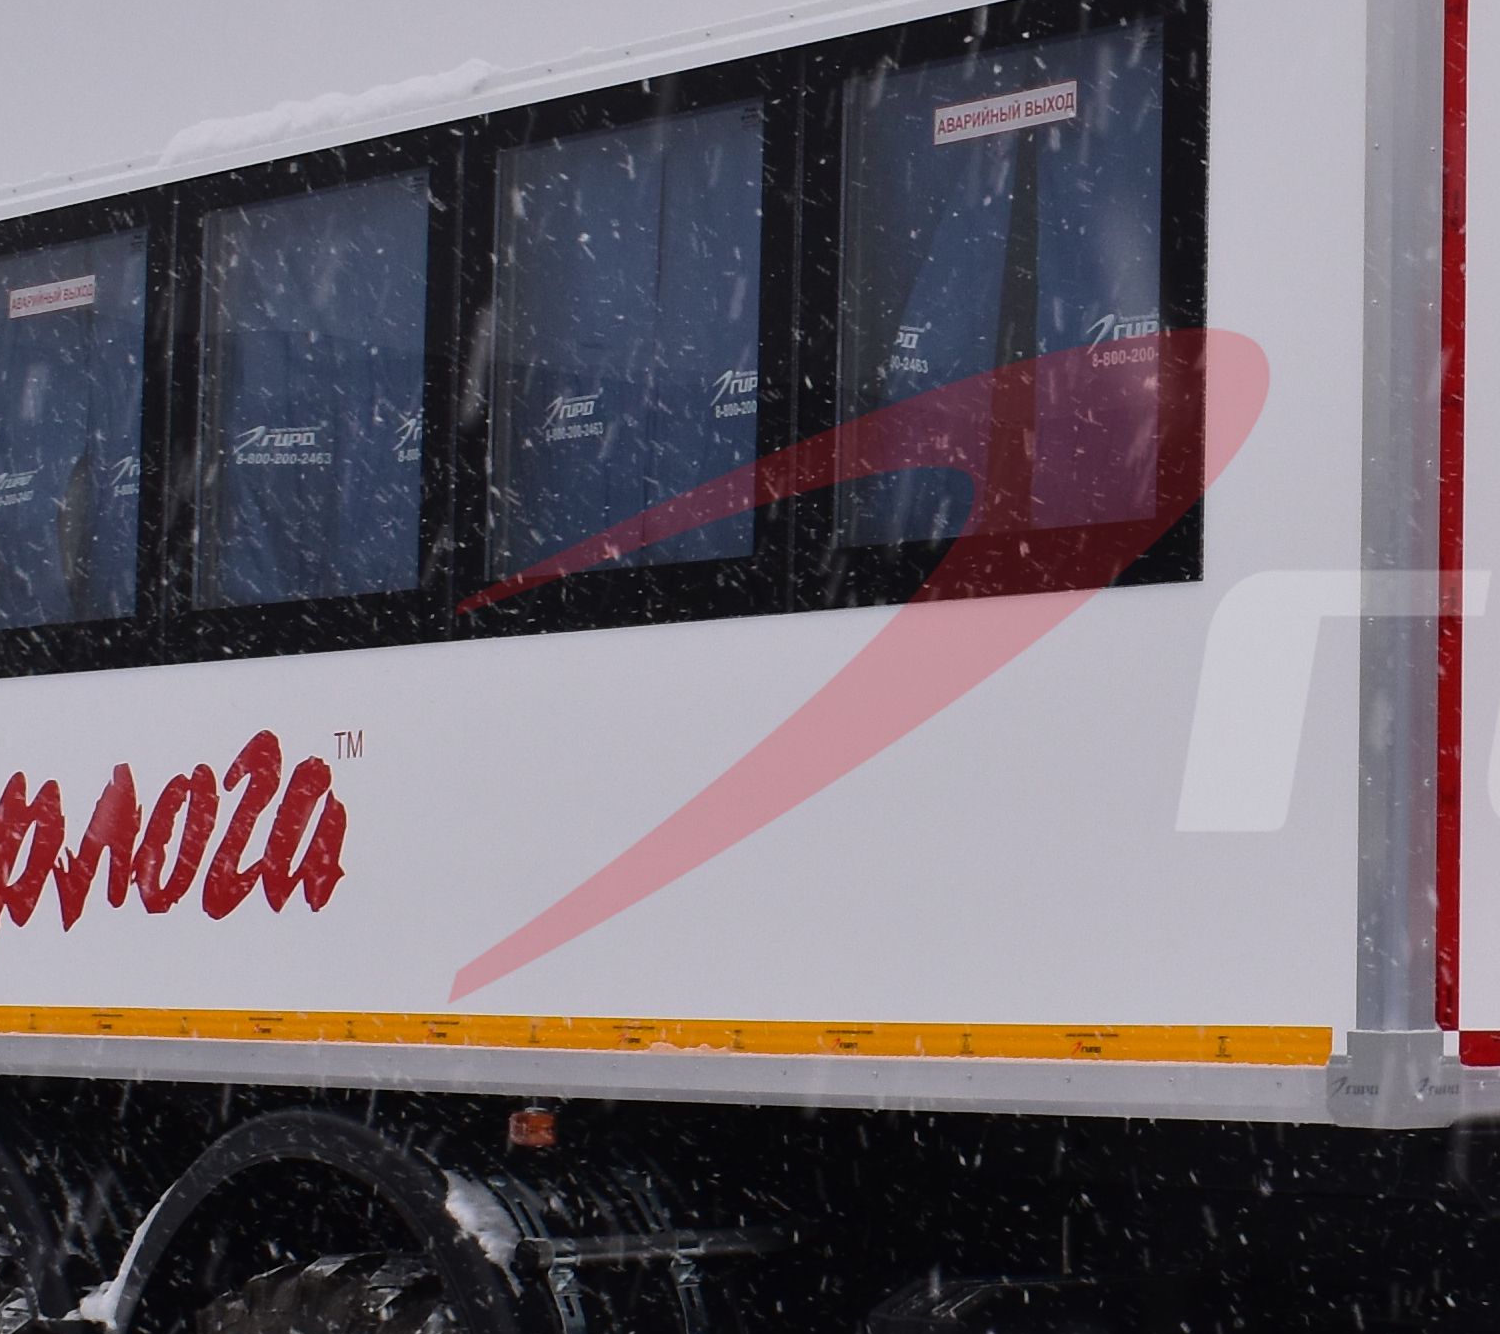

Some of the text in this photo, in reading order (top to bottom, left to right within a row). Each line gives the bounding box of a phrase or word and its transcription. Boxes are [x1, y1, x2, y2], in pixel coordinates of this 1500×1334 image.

[937, 91, 1075, 136] АВАРИЙНЫЙ ВЫХОД
[1113, 320, 1159, 341] ГИР
[1092, 346, 1159, 368] 8-800-200-
[730, 376, 758, 394] ГИР
[261, 432, 316, 447] ГИРД
